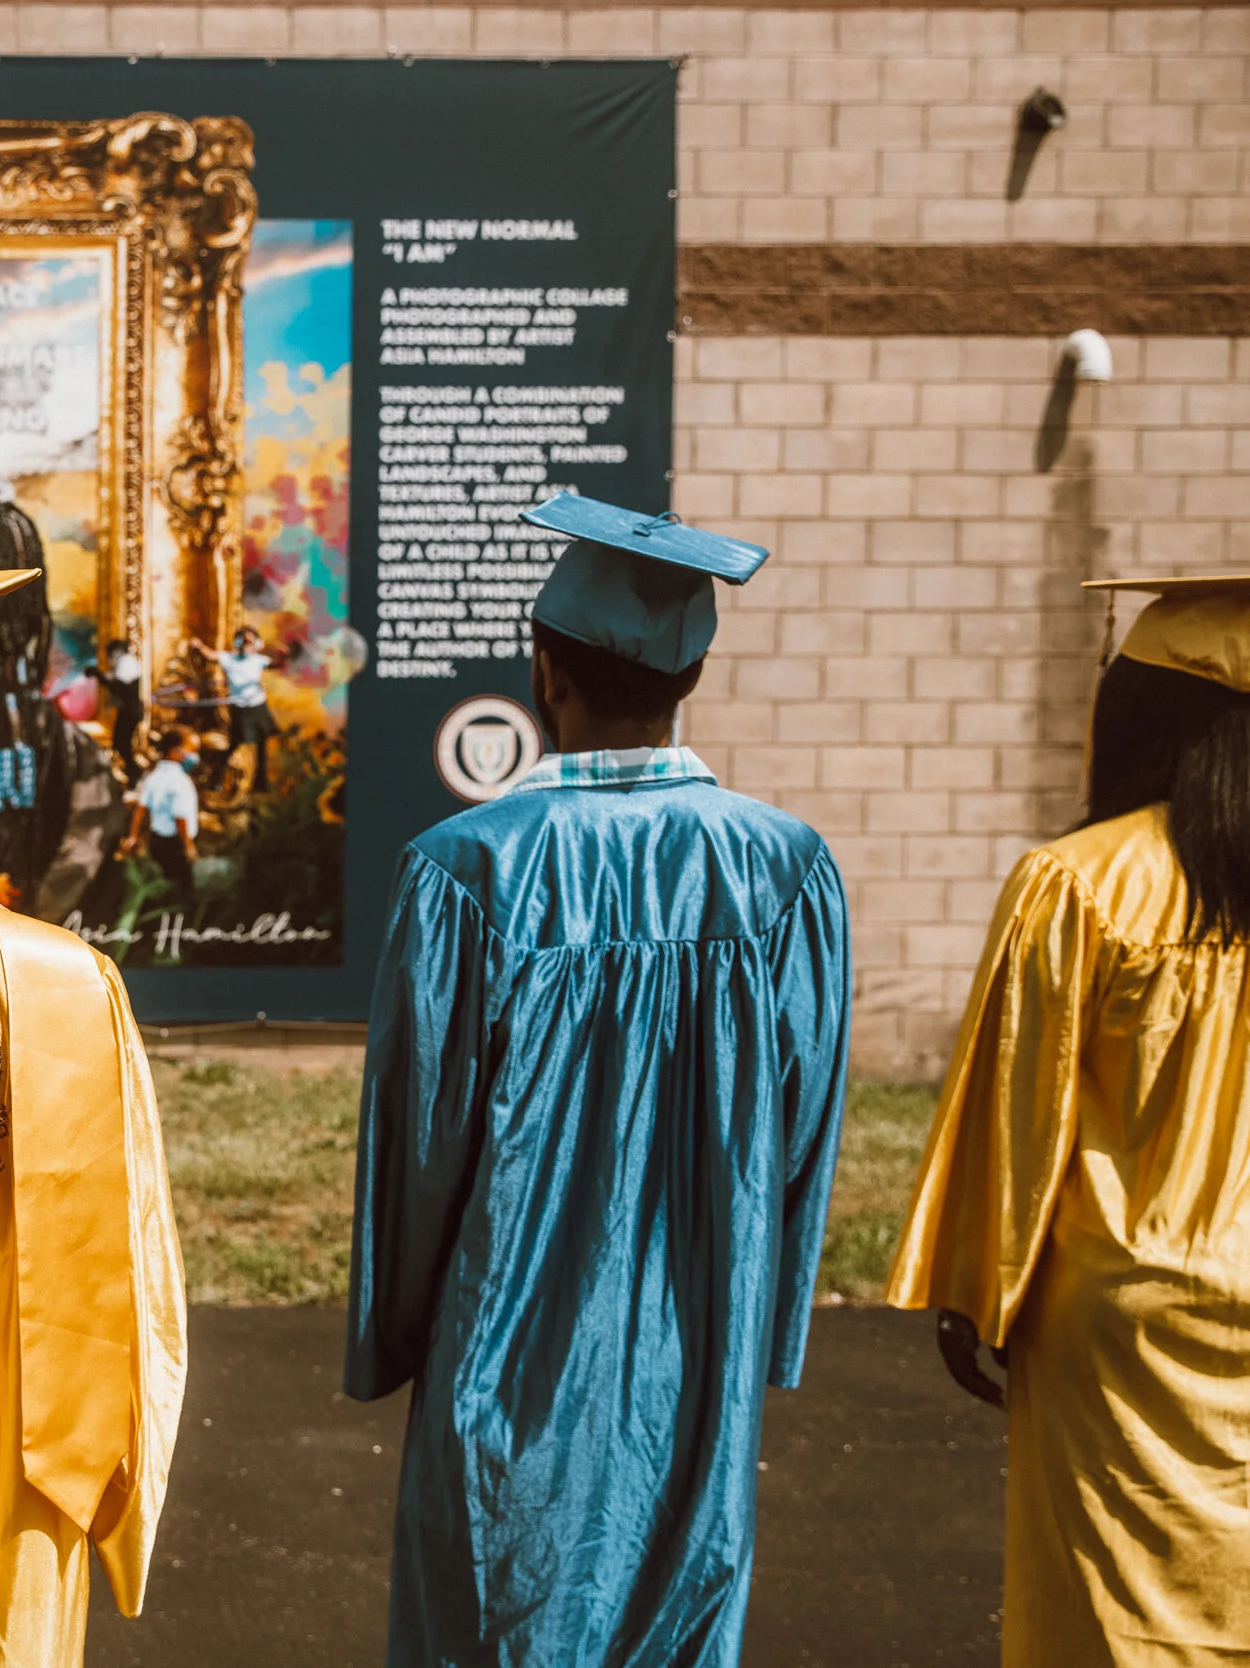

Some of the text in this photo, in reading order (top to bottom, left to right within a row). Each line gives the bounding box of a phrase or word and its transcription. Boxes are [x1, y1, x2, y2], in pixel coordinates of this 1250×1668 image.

[381, 219, 578, 240] THE NEW NORMAL
[381, 288, 628, 306] A PHOTOGRAPHIC COLLAGE
[381, 308, 576, 325] PHOTOGRAPHED AND
[380, 327, 575, 345] ASSEMBLED BY ARTIST
[380, 347, 525, 365] ASIA HAMILTON
[380, 386, 625, 404] THROUGH A COMBINATION
[379, 406, 610, 424] OF CANDID PORTRAITS OF
[379, 425, 587, 443] GEORGE WASHINGTON
[379, 445, 450, 463] CARVER
[550, 445, 627, 463] PAINTED
[379, 465, 547, 483] LANDSCAPES, AND
[473, 484, 533, 502] ARTIST
[379, 504, 476, 521] HAMILTON
[379, 523, 492, 541] UNTOUCHED
[378, 543, 405, 561] OF
[407, 543, 423, 560] A
[425, 543, 480, 560] CHILD
[482, 543, 508, 560] AS
[510, 543, 528, 560] IT
[530, 543, 549, 560] IS
[378, 563, 464, 580] LIMITLESS
[378, 582, 454, 600] CANVAS
[378, 602, 467, 619] CREATING
[470, 602, 522, 619] YOUR
[377, 622, 393, 638] A
[396, 621, 450, 638] PLACE
[453, 621, 517, 638] WHERE
[377, 641, 410, 658] THE
[414, 641, 489, 658] AUTHOR
[492, 641, 518, 658] OF
[153, 910, 331, 960] Hamilton
